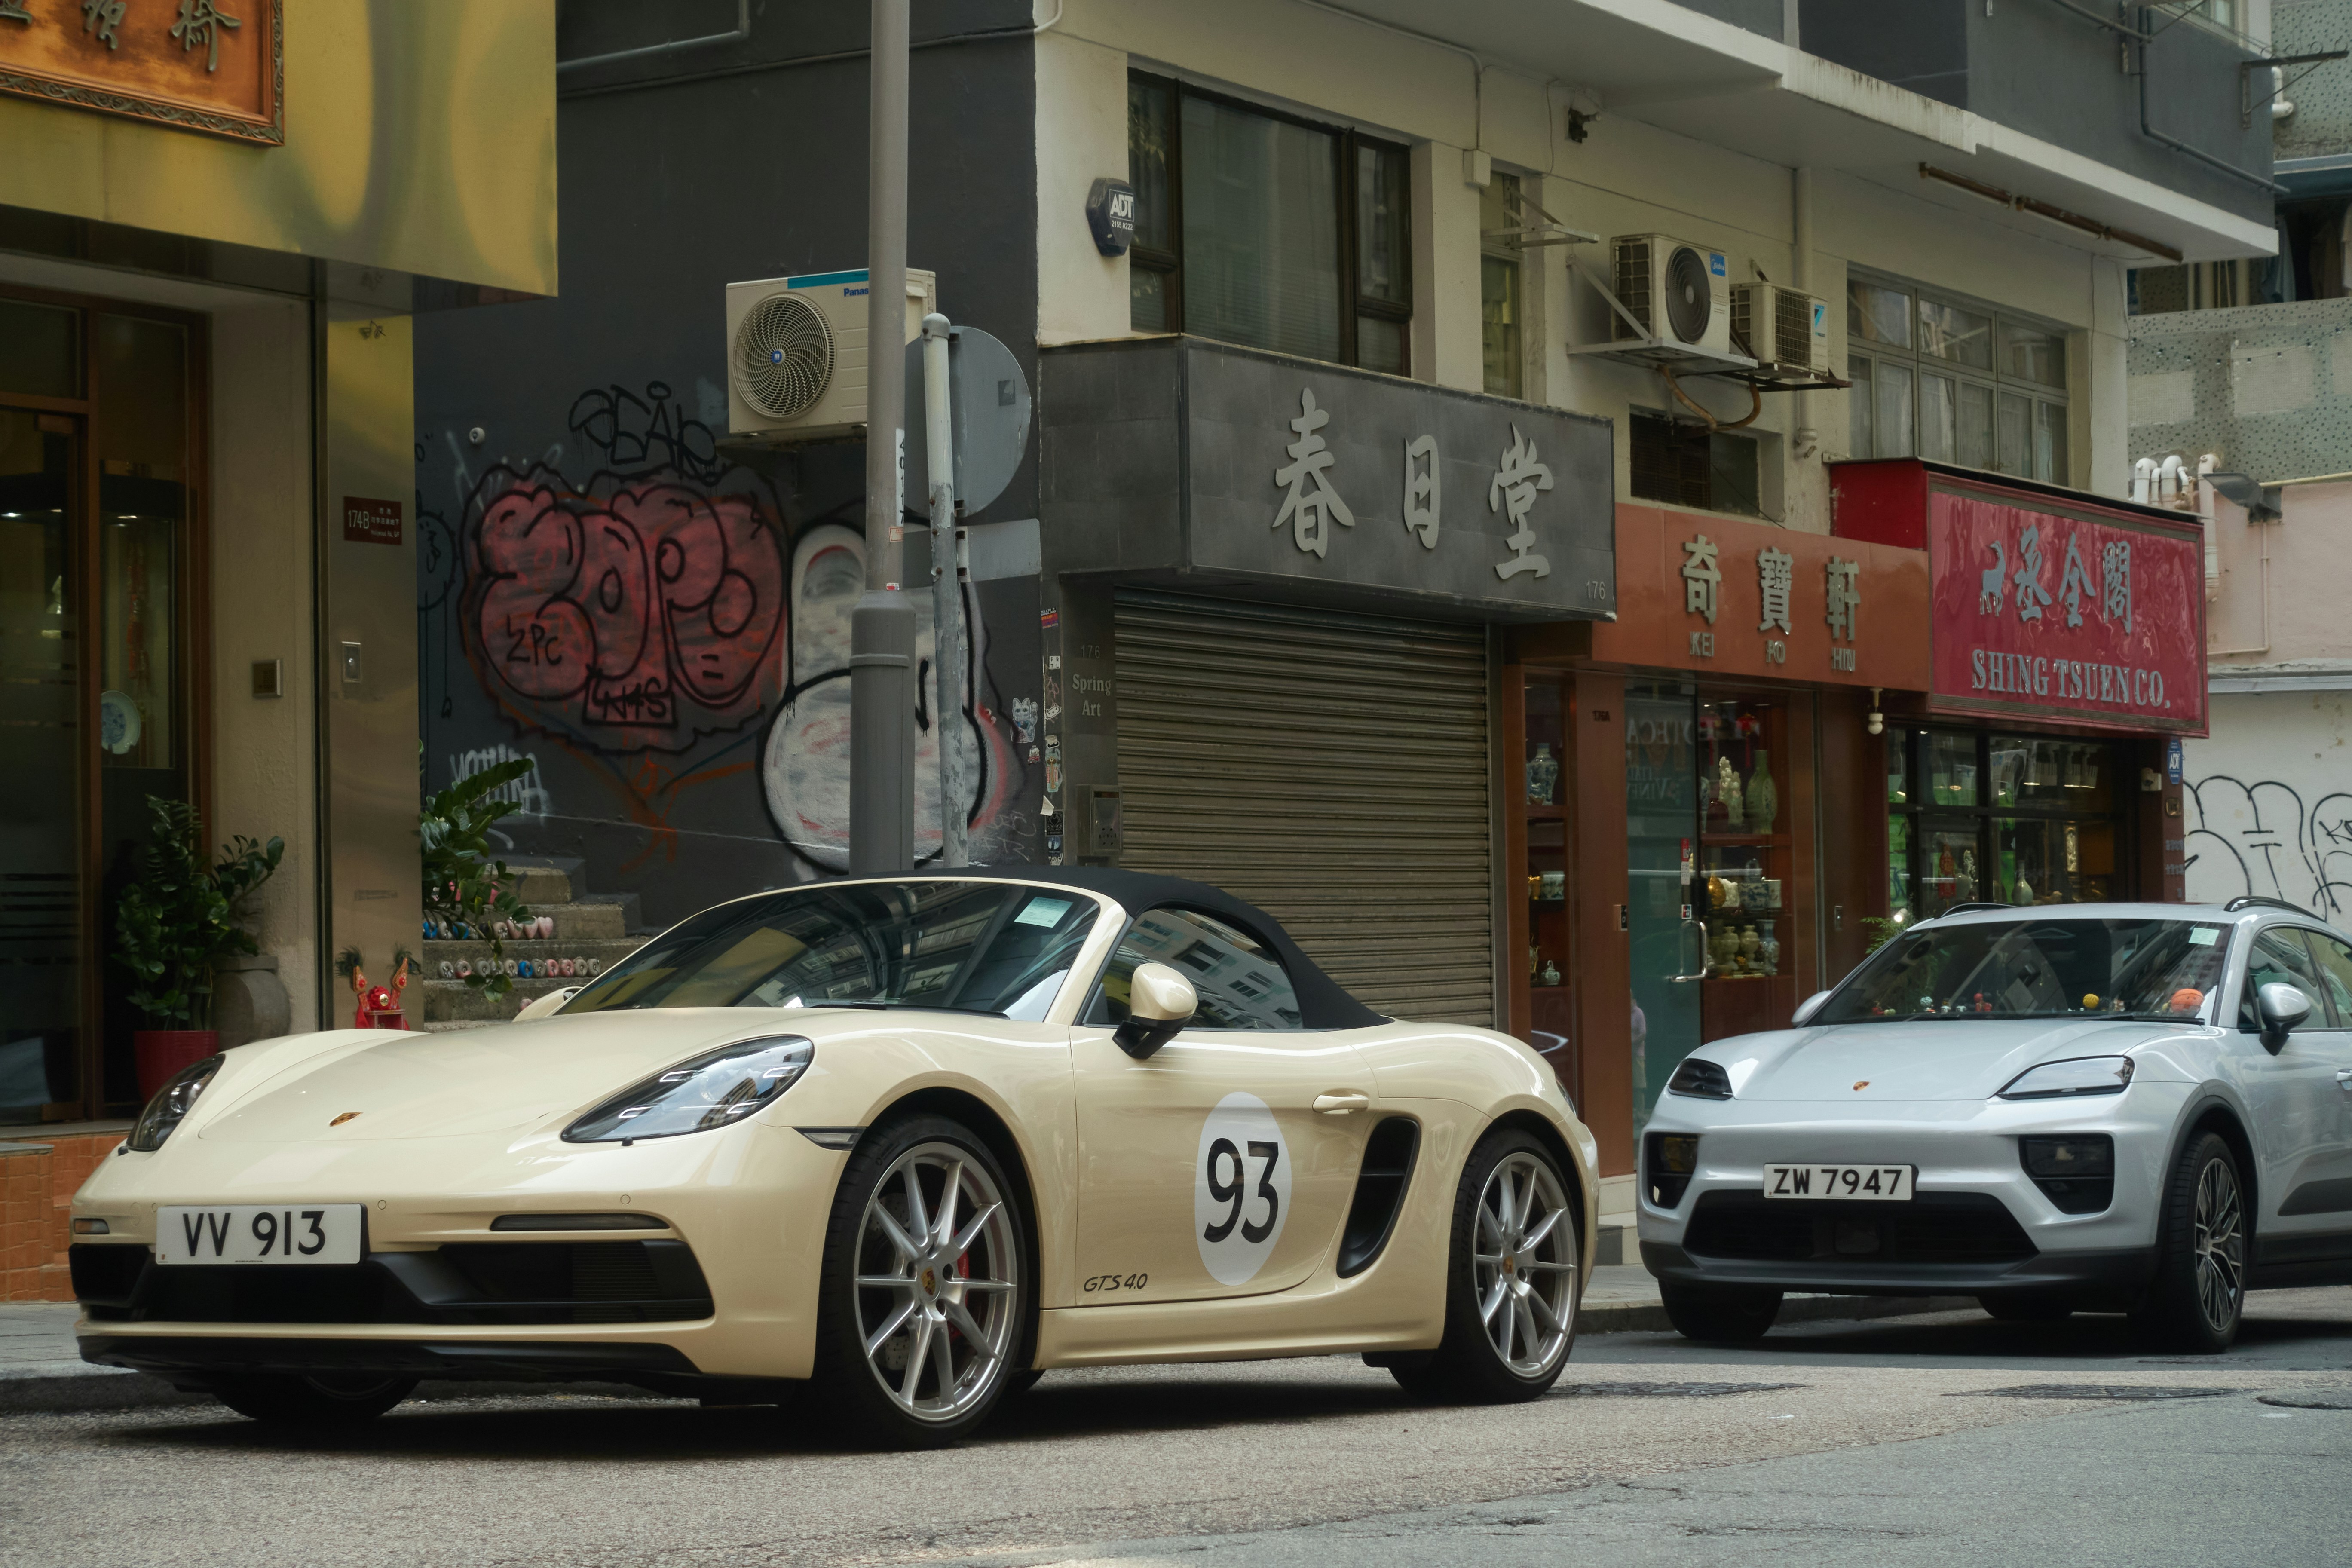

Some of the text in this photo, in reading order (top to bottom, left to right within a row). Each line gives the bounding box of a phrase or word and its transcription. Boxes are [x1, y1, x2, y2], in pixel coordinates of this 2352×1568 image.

[1110, 193, 1134, 218] ADT
[1112, 220, 1133, 230] 2155 0222
[1272, 387, 1554, 579] 春日堂
[348, 509, 370, 529] 174B
[1586, 580, 1606, 600] 176
[1682, 533, 1860, 641] 奇寶軒
[1081, 645, 1100, 658] 176
[1690, 631, 1856, 672] KEI PO HIN
[1072, 673, 1111, 696] Spring
[1972, 649, 2171, 709] SHING TSUEN CO.
[1082, 700, 1101, 717] Art
[2169, 753, 2180, 769] ADT
[1204, 1137, 1280, 1243] 93
[1773, 1168, 1902, 1195] ZW 7947
[183, 1210, 326, 1257] VV 913
[1083, 1272, 1148, 1292] GTS 4.0
